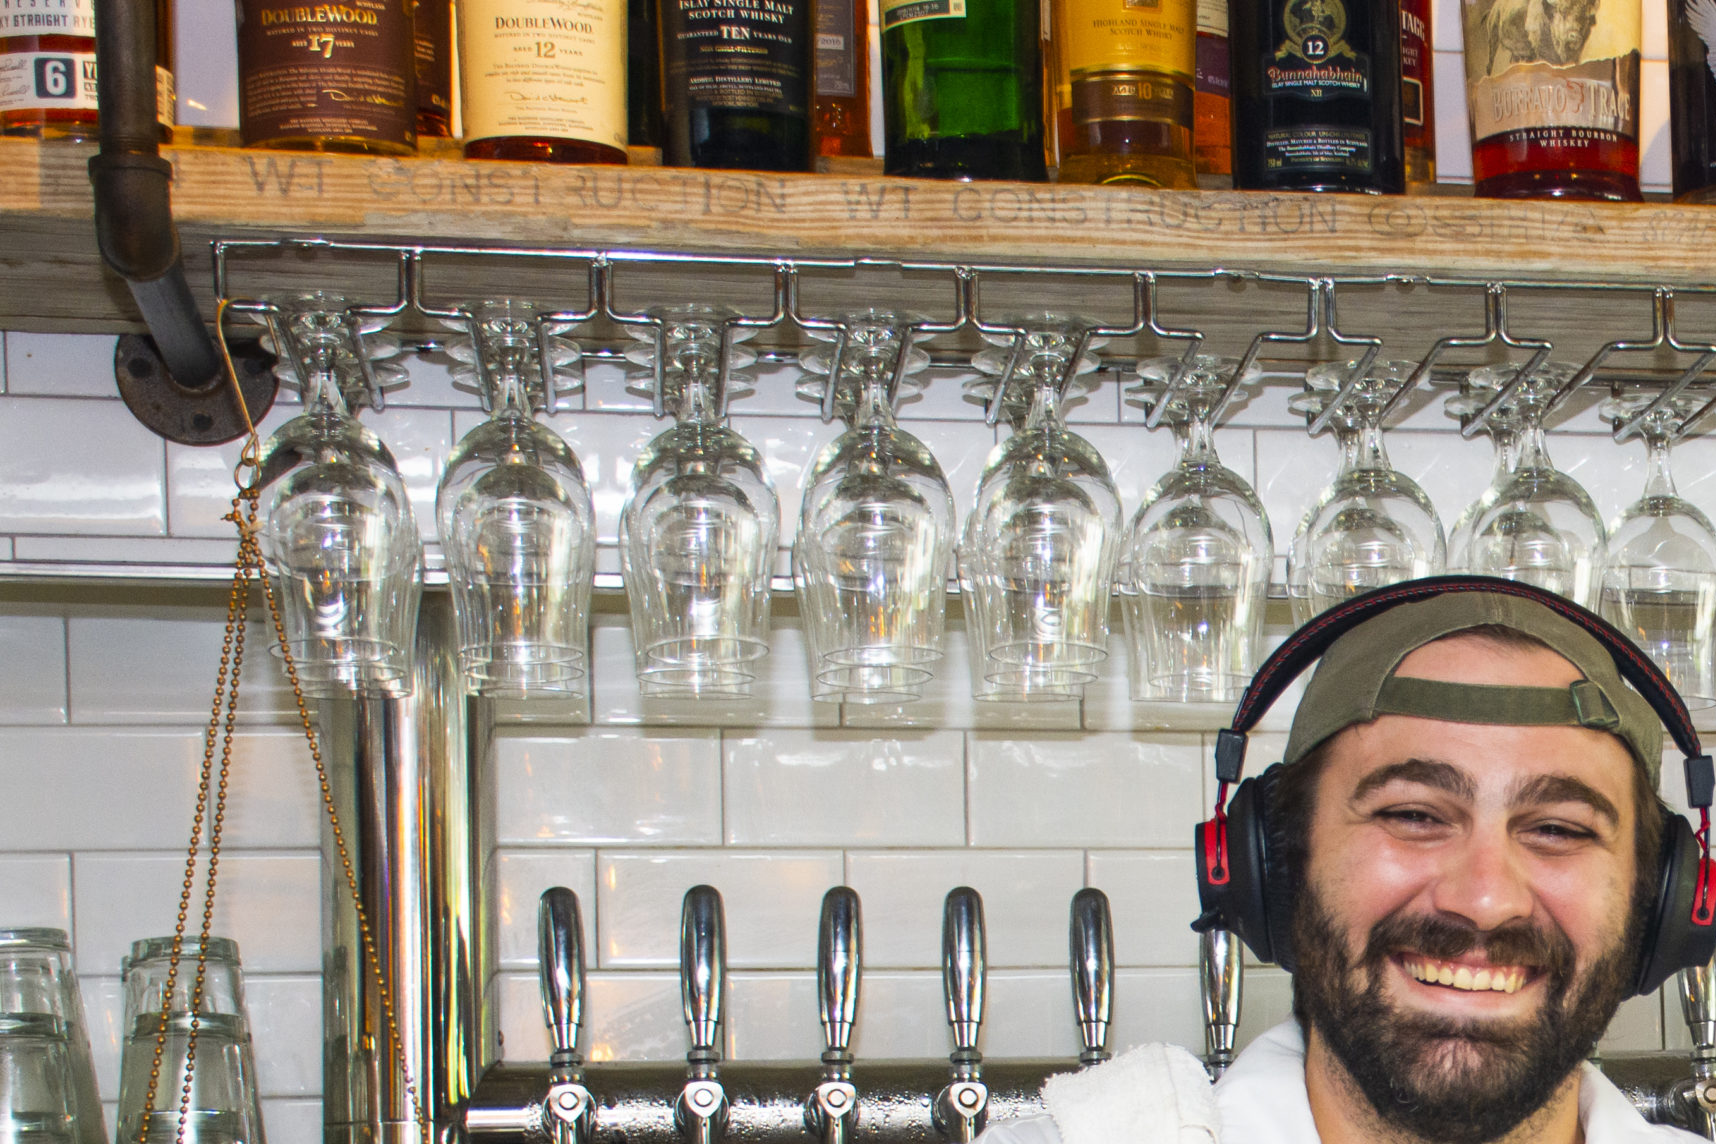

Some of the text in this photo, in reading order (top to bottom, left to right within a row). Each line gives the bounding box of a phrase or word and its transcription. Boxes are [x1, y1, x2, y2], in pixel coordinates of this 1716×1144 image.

[765, 0, 794, 15] MALT
[13, 14, 68, 27] STRAIGHT
[495, 16, 592, 34] DOUBLEWOOD
[688, 10, 785, 24] SCOTCH WHISKY
[720, 25, 750, 40] TEN
[308, 33, 335, 58] 17
[535, 41, 556, 59] 12
[1306, 41, 1324, 55] 12
[45, 60, 67, 96] 6
[1268, 65, 1362, 83] Bunnahabhain
[1138, 82, 1152, 99] 10
[1491, 82, 1631, 122] BUFFALO TRACE
[1510, 130, 1617, 142] STRAIGHT BOURBON
[1540, 140, 1589, 148] WHISKEY
[952, 184, 1338, 234] CONSTRUCTION
